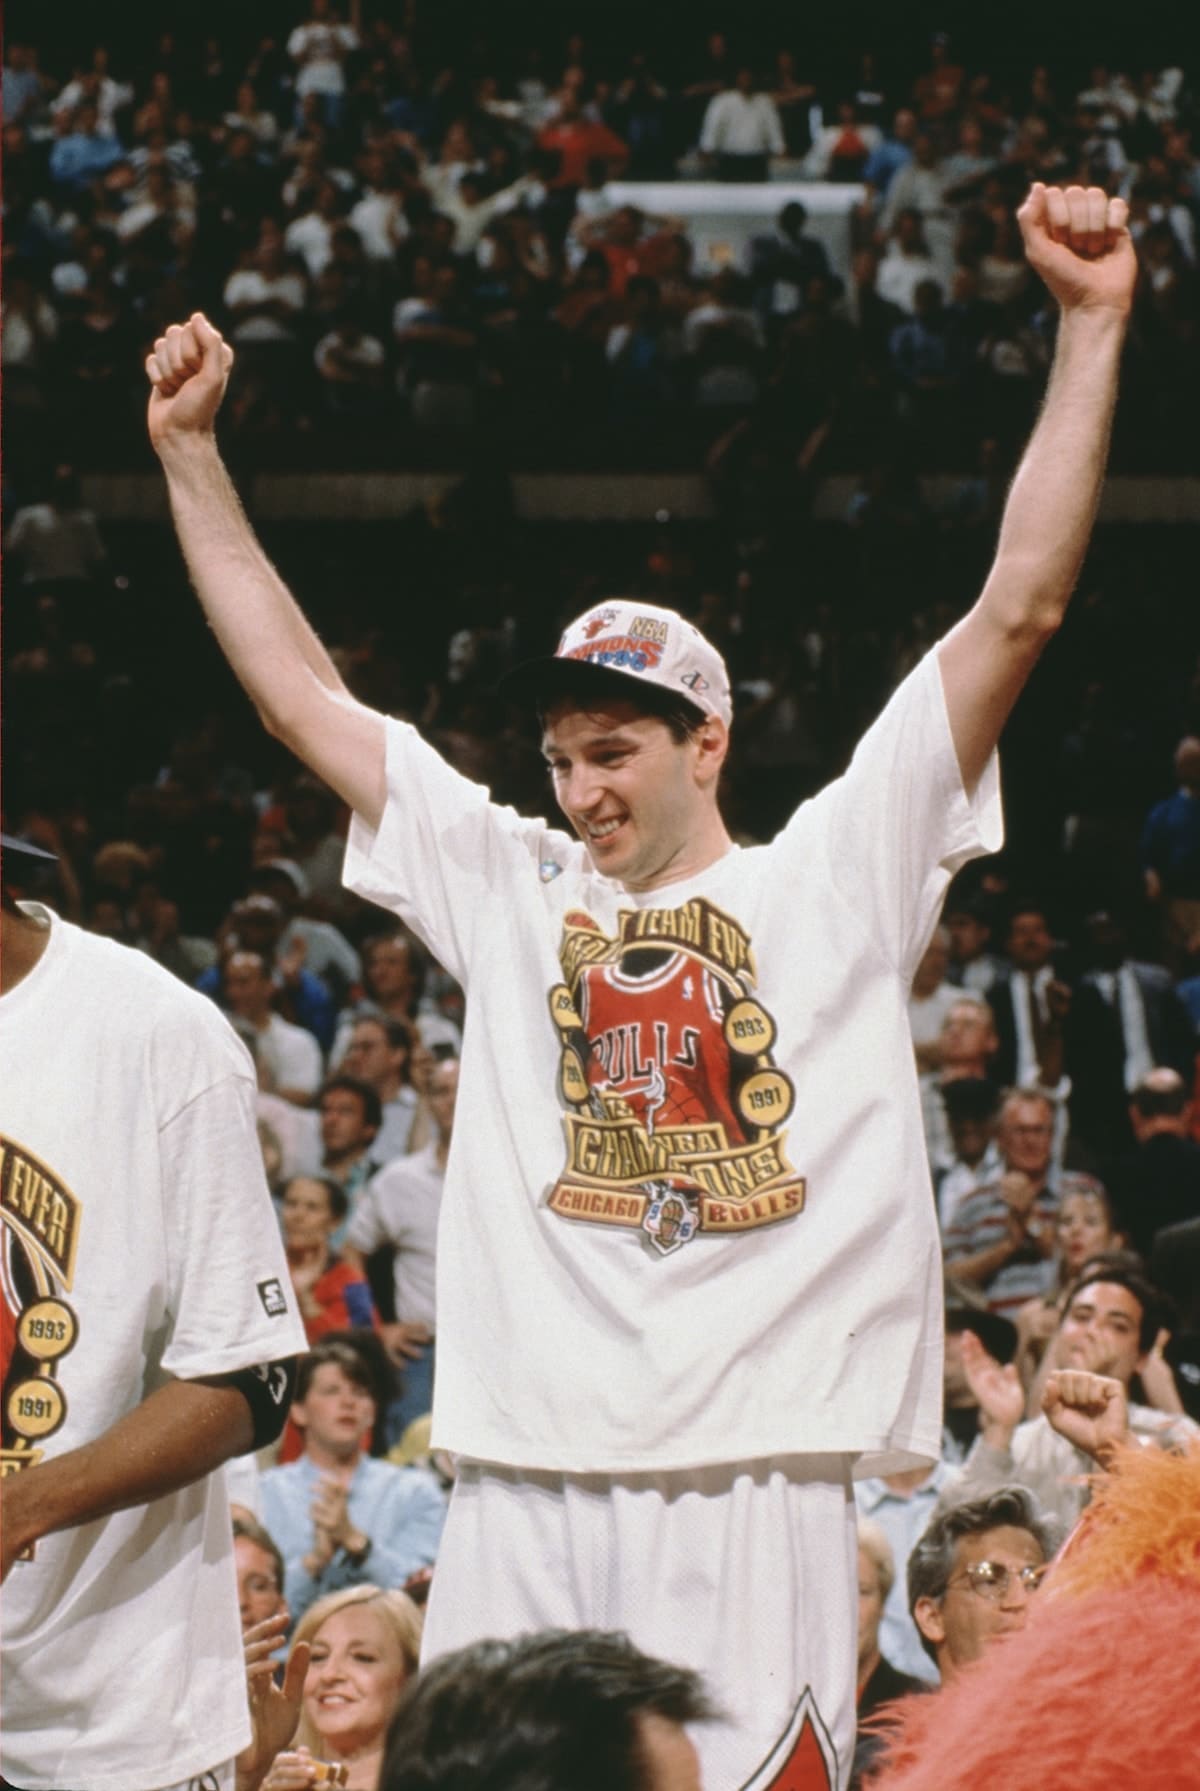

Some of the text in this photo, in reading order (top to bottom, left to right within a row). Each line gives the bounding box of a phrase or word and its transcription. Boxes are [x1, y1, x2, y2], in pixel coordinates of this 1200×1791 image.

[628, 616, 668, 644] NBA
[636, 902, 700, 947] TEAM
[732, 1018, 766, 1039] 1993
[747, 1086, 782, 1110] 1991
[652, 1132, 718, 1153] NBA
[8, 1155, 68, 1258] EVER
[557, 1189, 641, 1219] CHICAGO
[708, 1189, 800, 1223] BULLS
[28, 1318, 66, 1341] 1993
[17, 1397, 52, 1418] 1991
